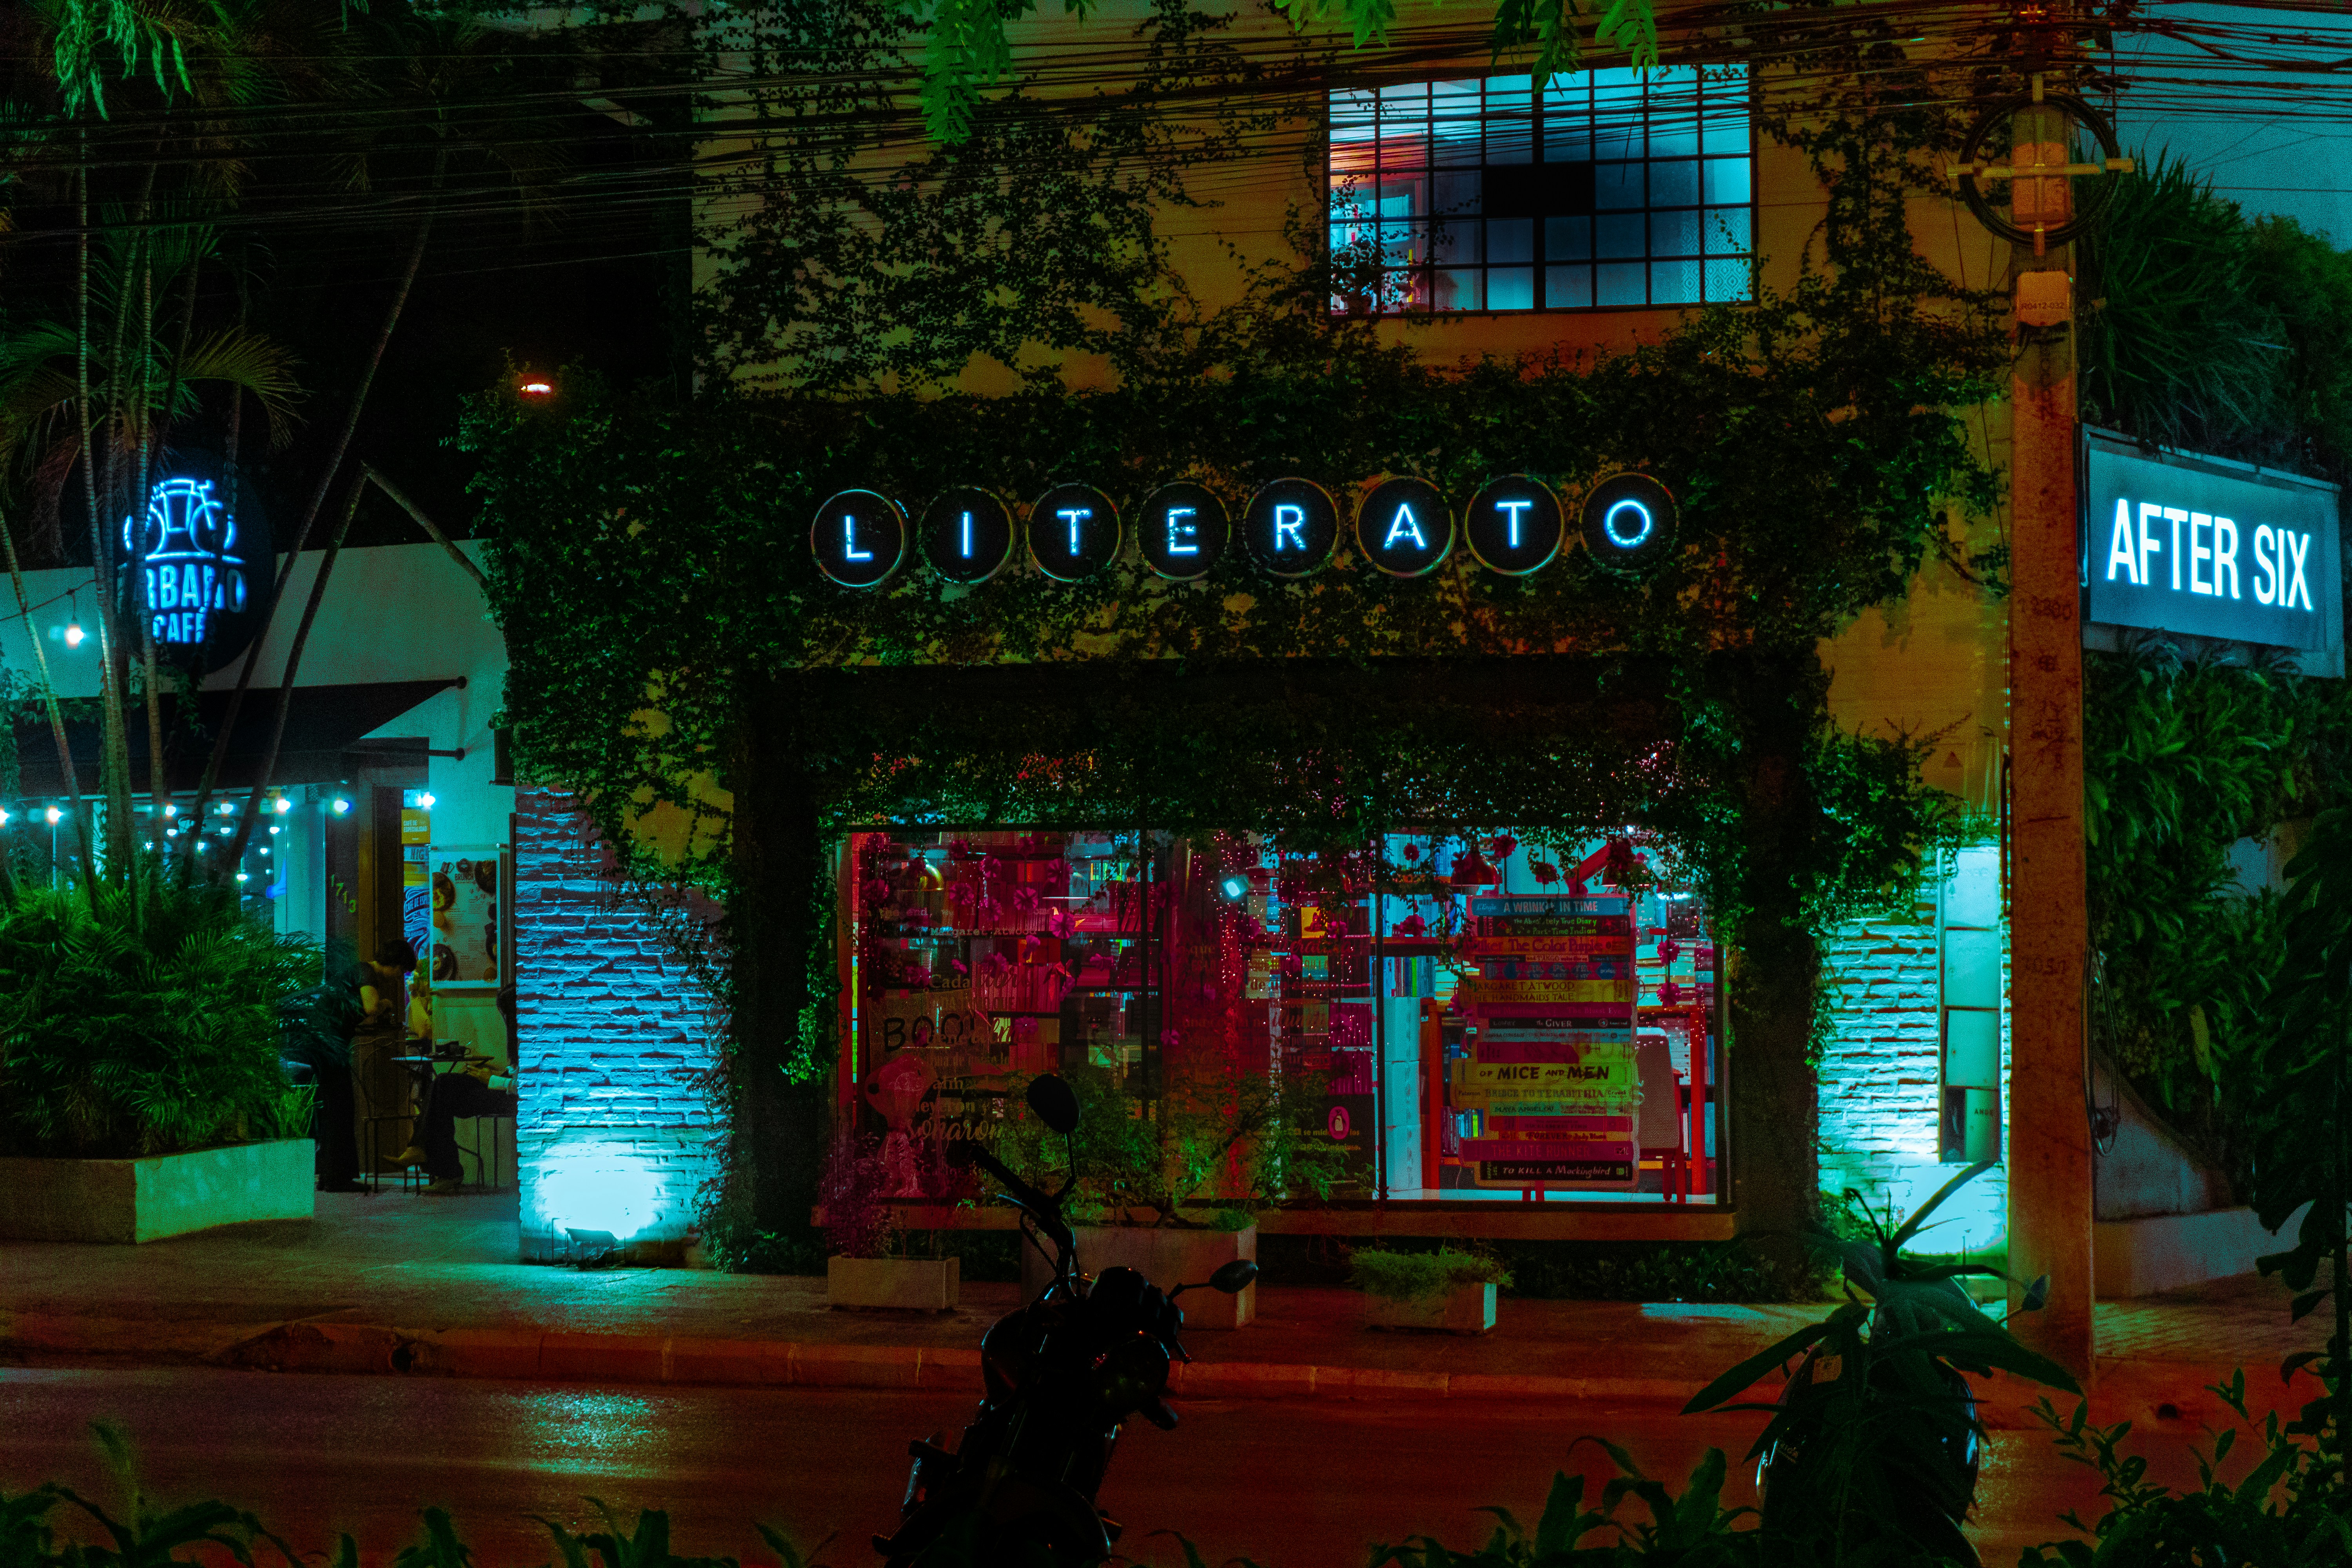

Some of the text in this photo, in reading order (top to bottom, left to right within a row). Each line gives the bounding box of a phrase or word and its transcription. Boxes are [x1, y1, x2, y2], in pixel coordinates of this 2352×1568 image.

[845, 499, 1650, 560] LITERATO
[2107, 497, 2313, 612] AFTER SIX
[331, 874, 356, 913] 1713
[1504, 902, 1510, 913] A
[1560, 902, 1570, 913] IN
[1574, 901, 1597, 912] TIME
[1576, 917, 1597, 926] Diary
[930, 927, 989, 937] Margaret
[1570, 926, 1596, 935] Indian
[1509, 939, 1529, 951] The
[1532, 938, 1567, 952] Color
[1569, 938, 1602, 954] Purple
[929, 974, 970, 988] Cada
[1528, 982, 1575, 991] ATWOOD
[1468, 993, 1486, 1002] THE
[1492, 993, 1549, 1002] HANDMAID'S
[1608, 1007, 1622, 1016] Eye
[1545, 1019, 1572, 1027] GIVER
[1497, 1066, 1540, 1080] MICE
[1566, 1065, 1610, 1080] MEN
[1522, 1089, 1535, 1098] TO
[1492, 1144, 1590, 1157] THE KITE RUNNER
[1555, 1165, 1611, 1179] Mockingbird
